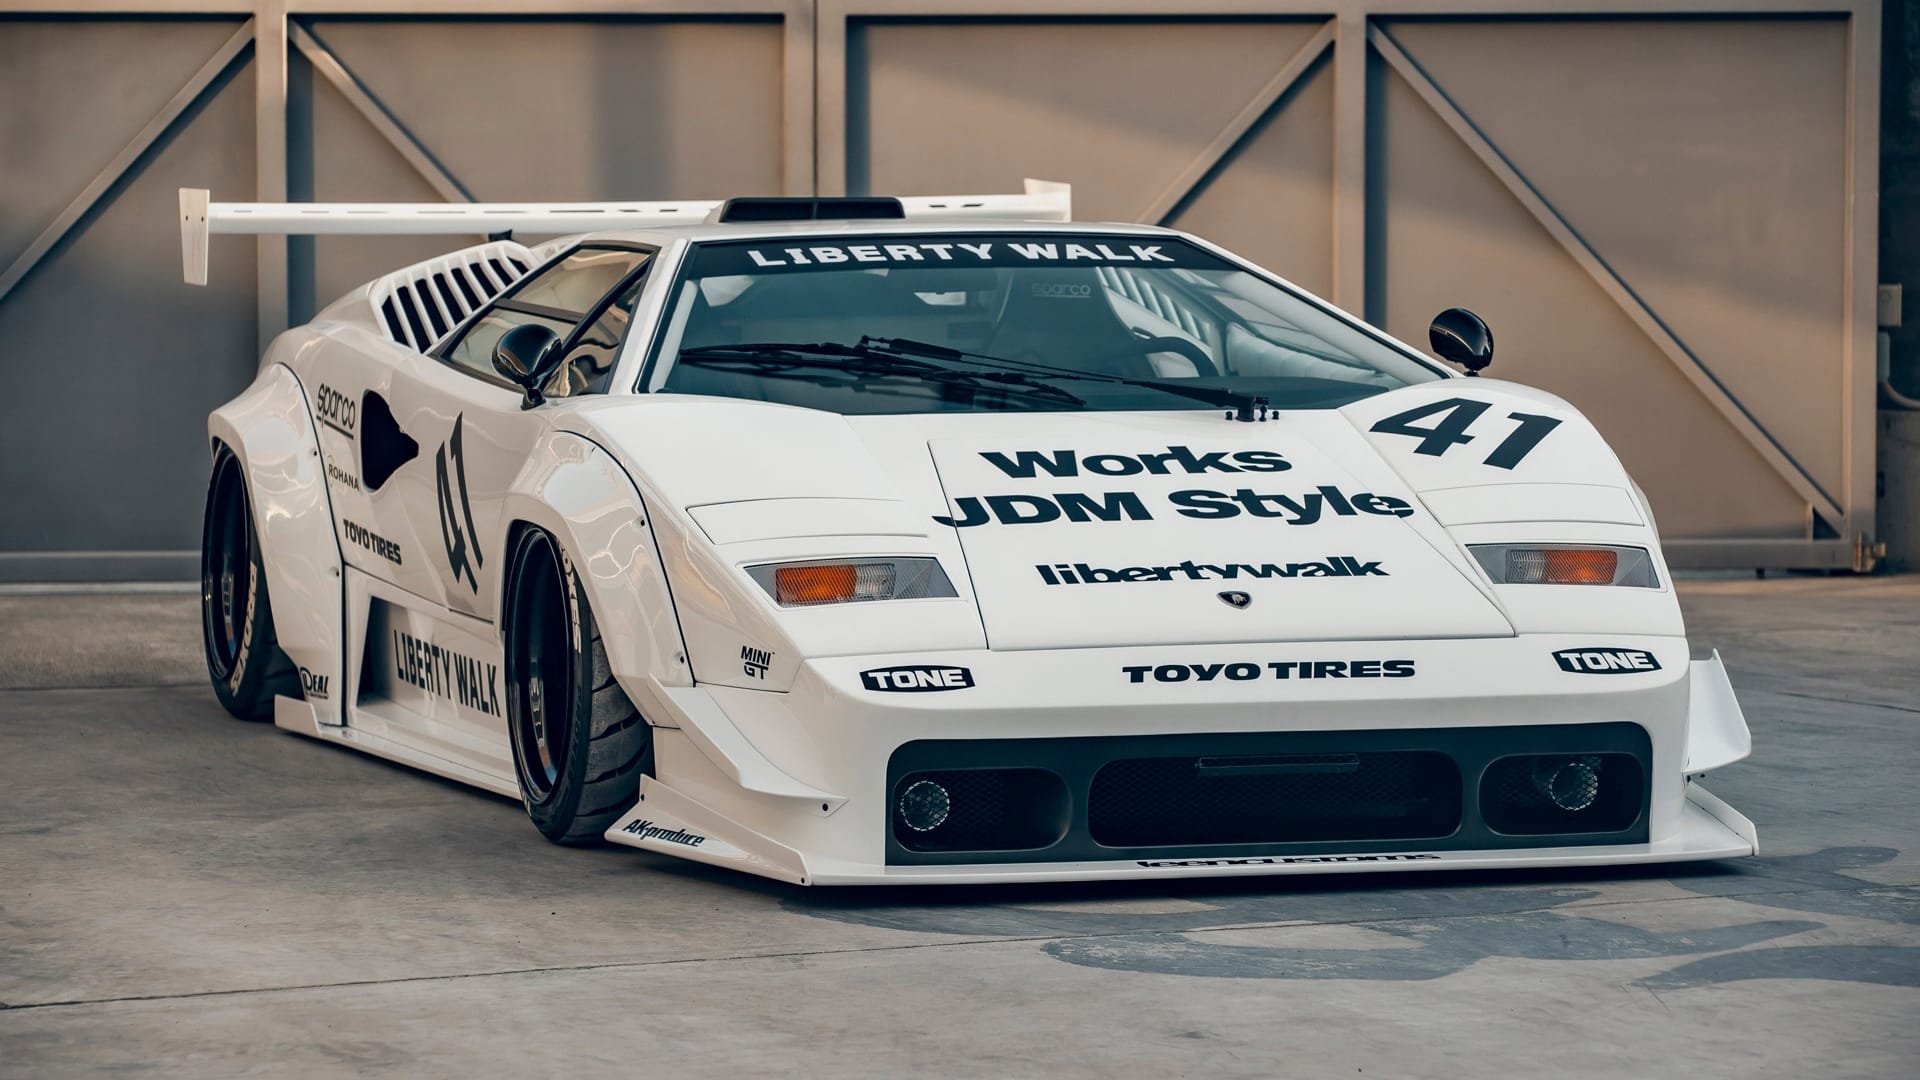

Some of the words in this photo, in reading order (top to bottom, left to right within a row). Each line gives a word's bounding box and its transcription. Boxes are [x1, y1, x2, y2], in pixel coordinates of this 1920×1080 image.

[748, 243, 993, 267] LIBERTY
[1006, 242, 1176, 263] WALK
[316, 383, 356, 430] sparco
[1369, 397, 1562, 470] 41
[978, 446, 1293, 478] Works
[328, 463, 360, 491] ROHANA
[436, 411, 484, 596] 41
[932, 492, 1153, 528] JDM
[1168, 485, 1415, 526] Style
[343, 519, 370, 550] TOYO
[370, 532, 402, 566] TIRES
[1035, 556, 1391, 585] libertywalk
[741, 645, 771, 666] MINI
[1560, 652, 1655, 671] TONE
[394, 629, 451, 700] LIBERTY
[453, 652, 501, 718] WALK
[744, 661, 769, 680] GT
[868, 669, 967, 689] TONE
[1122, 663, 1261, 683] TOYO
[1268, 660, 1416, 679] TIRES
